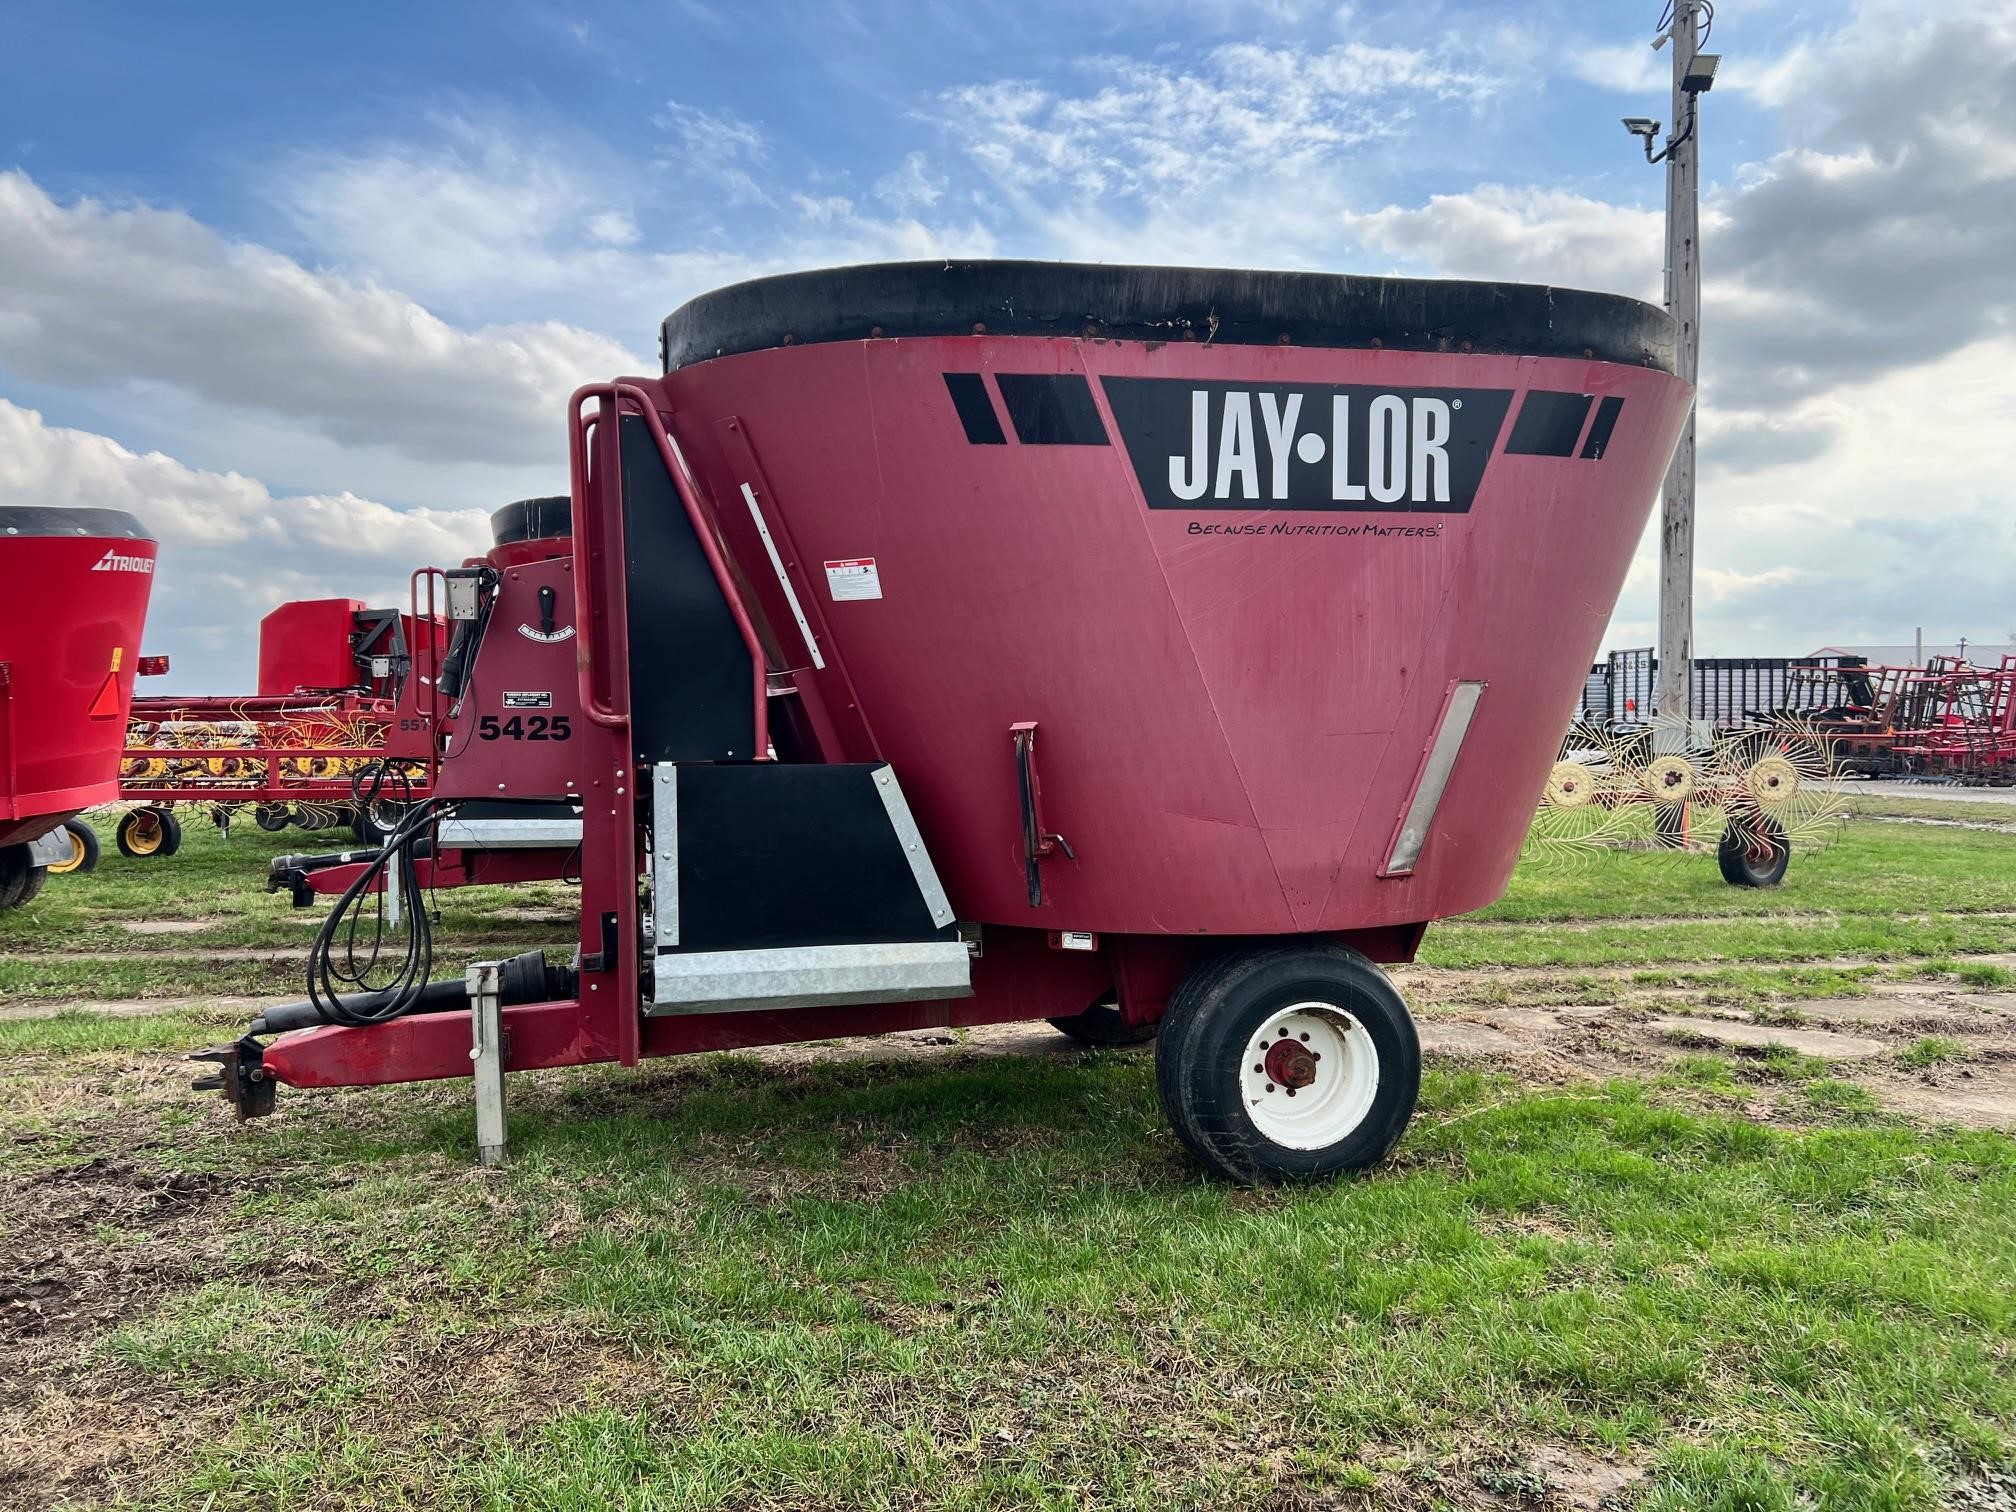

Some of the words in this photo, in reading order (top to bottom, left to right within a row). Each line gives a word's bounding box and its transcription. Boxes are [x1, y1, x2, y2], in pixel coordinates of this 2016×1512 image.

[1187, 521, 1267, 535] BECAUSE
[1269, 521, 1361, 537] NUTRITION
[479, 715, 572, 741] 5425
